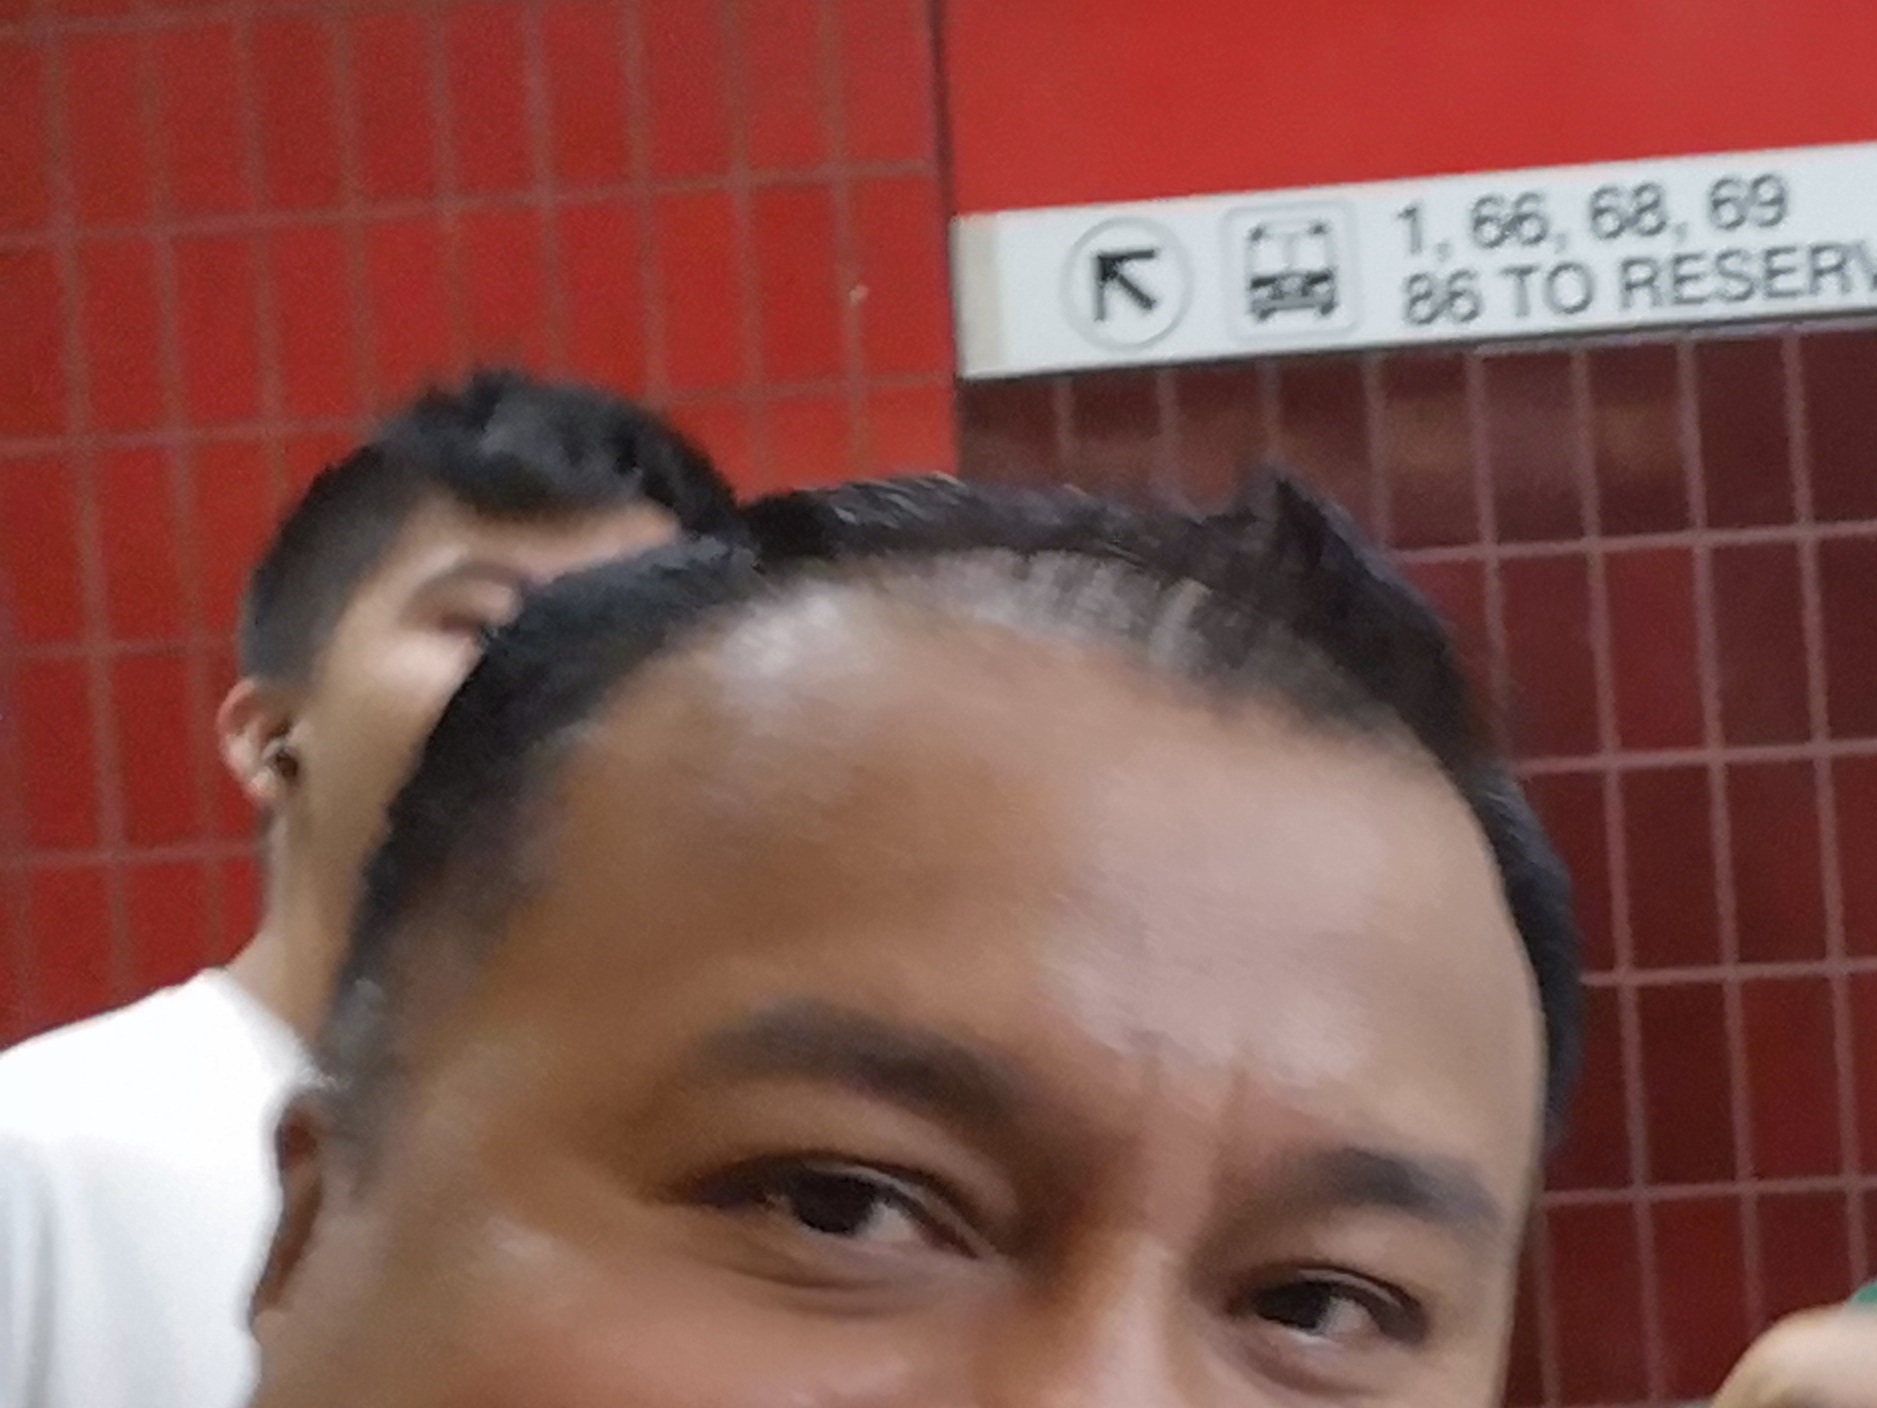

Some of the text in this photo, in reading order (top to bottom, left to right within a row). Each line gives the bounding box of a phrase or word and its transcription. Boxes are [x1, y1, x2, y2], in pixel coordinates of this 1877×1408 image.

[1709, 172, 1789, 231] 69
[1403, 266, 1484, 327] 86
[1500, 259, 1598, 317] TO
